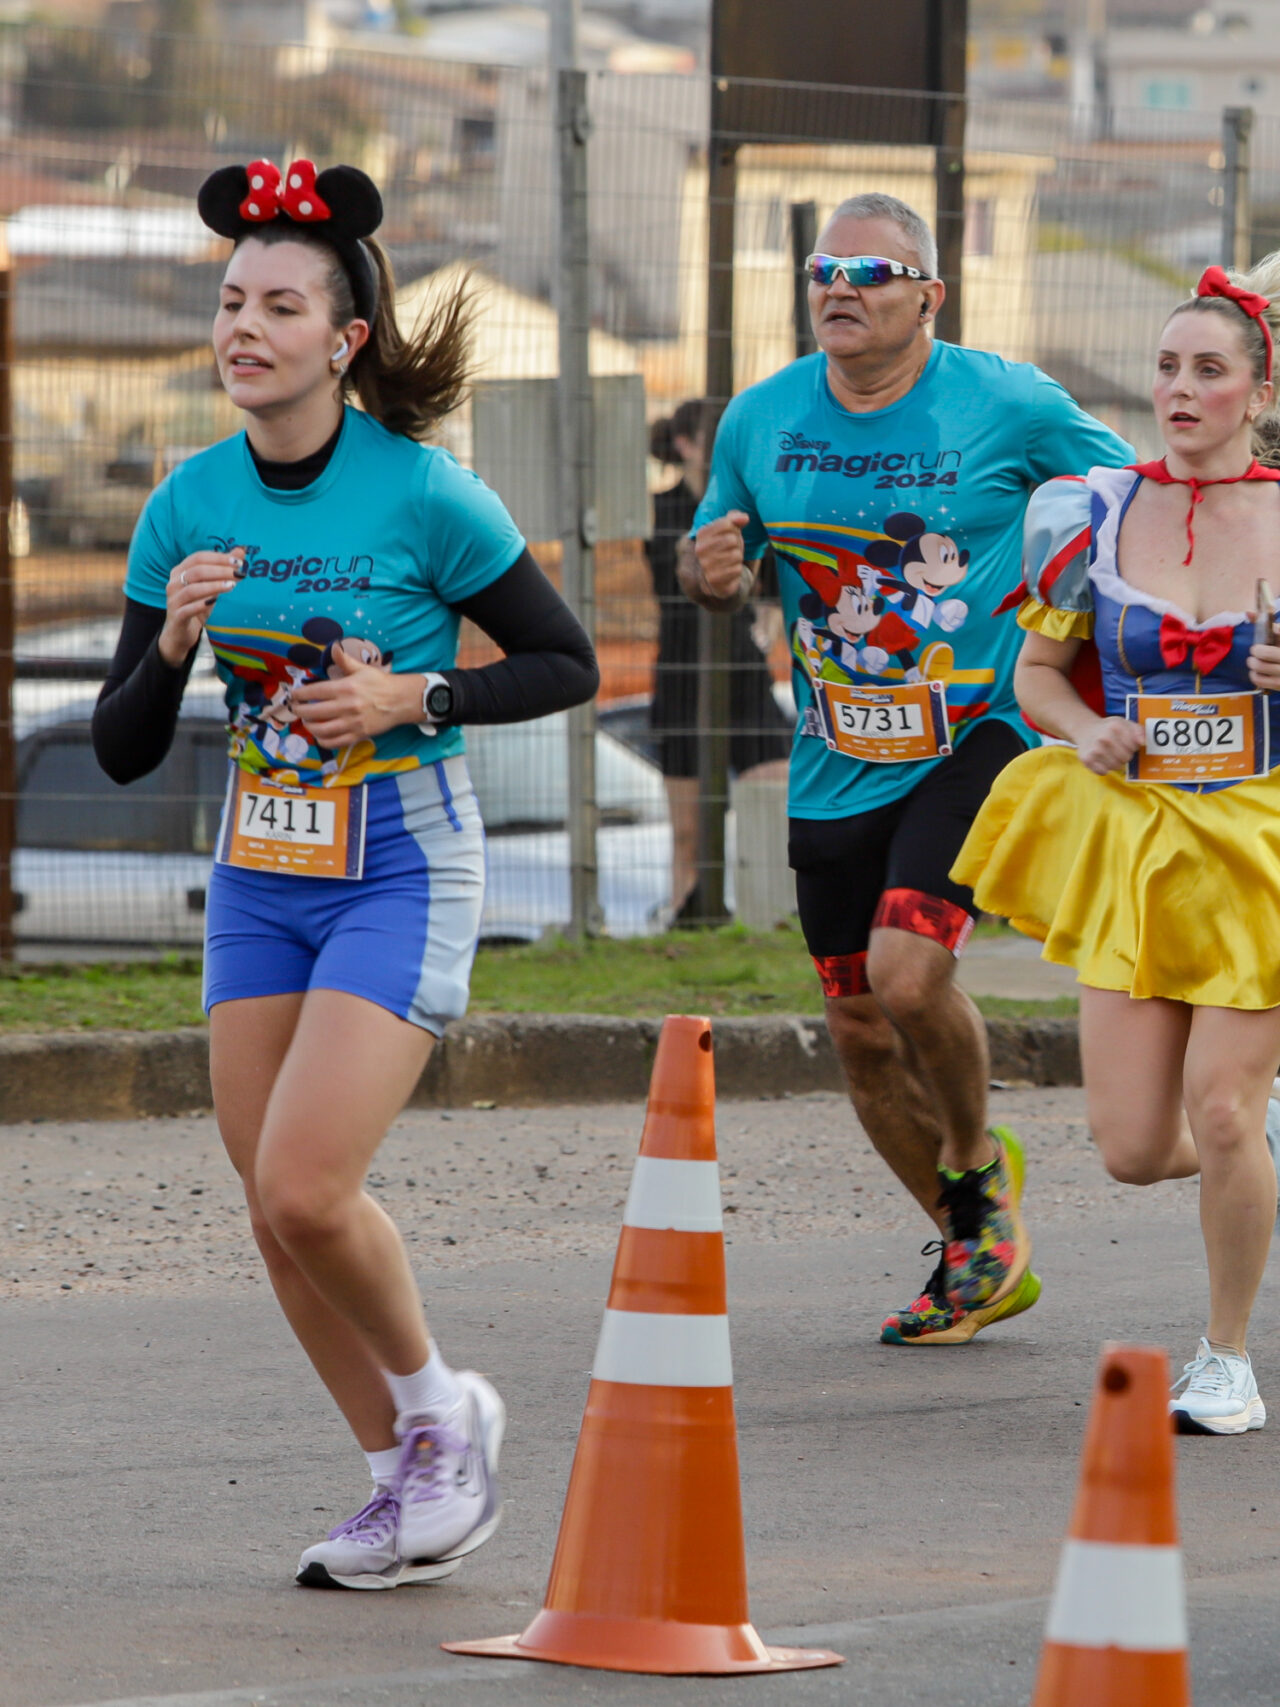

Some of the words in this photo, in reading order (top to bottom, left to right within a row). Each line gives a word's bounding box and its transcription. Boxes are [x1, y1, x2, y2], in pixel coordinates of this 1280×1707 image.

[874, 471, 958, 489] 2024
[295, 577, 371, 593] 2024
[841, 704, 912, 732] 5731
[1153, 718, 1234, 747] 6802
[247, 794, 320, 834] 7411
